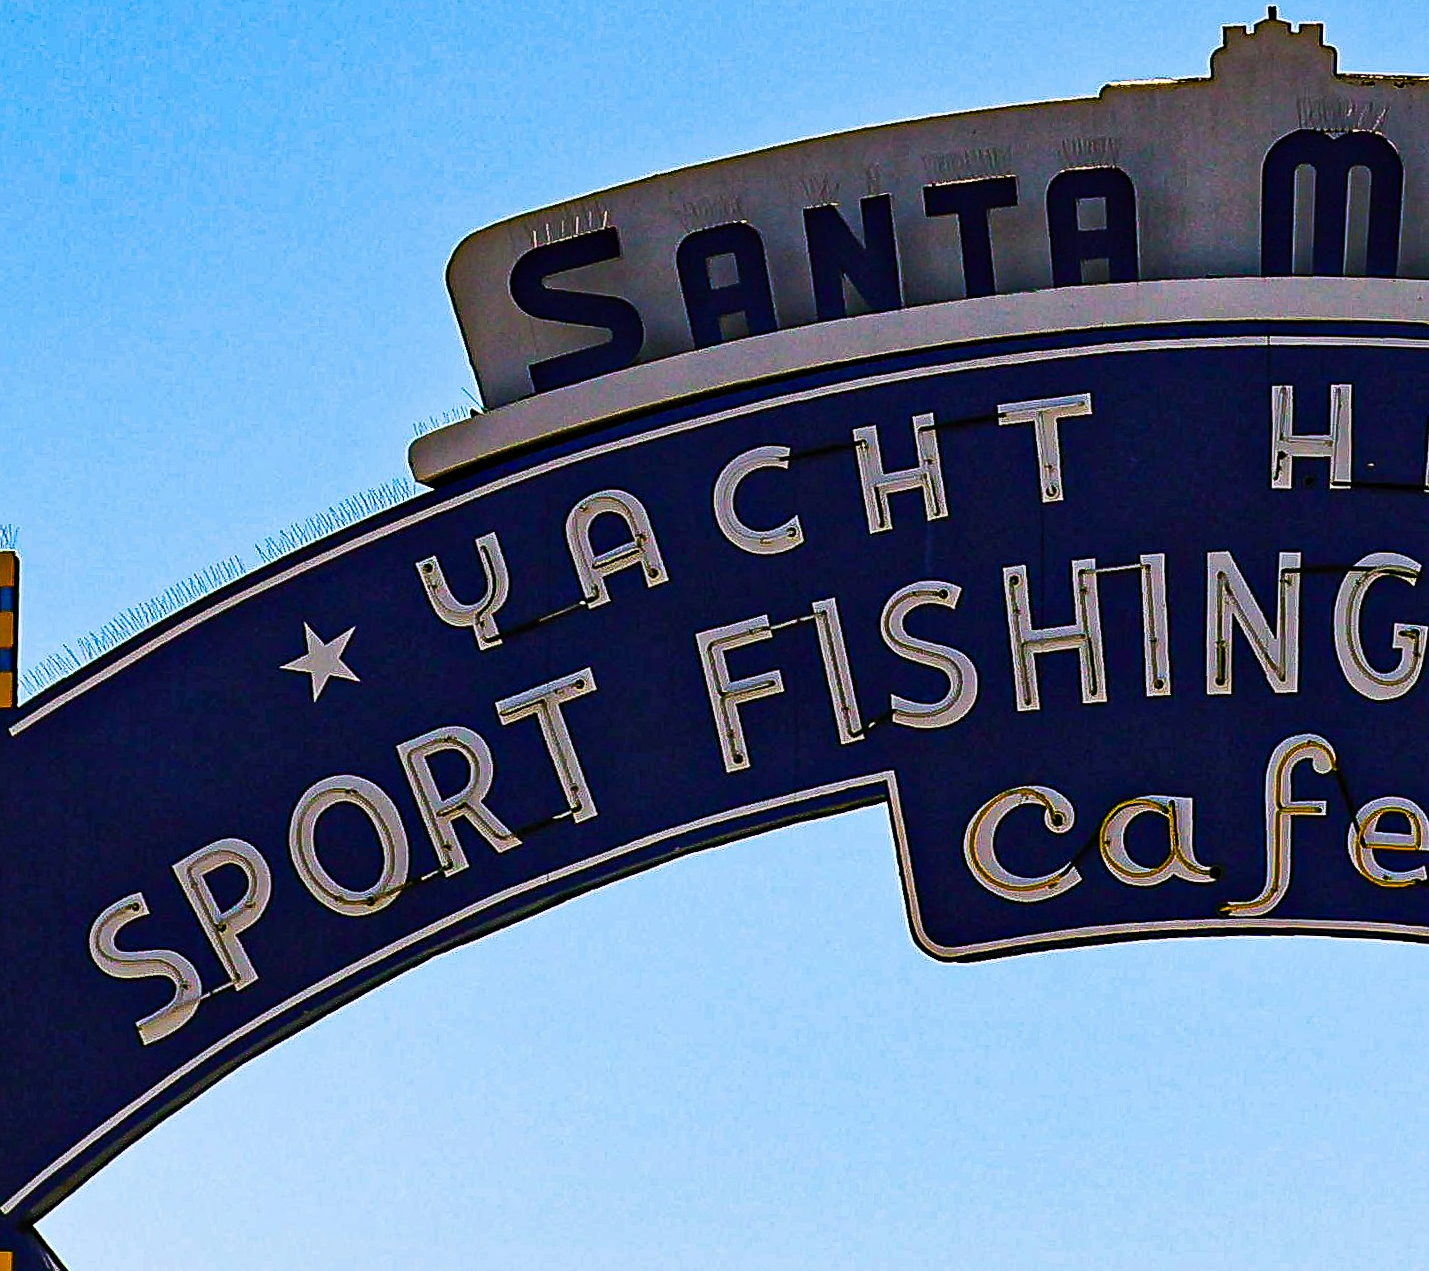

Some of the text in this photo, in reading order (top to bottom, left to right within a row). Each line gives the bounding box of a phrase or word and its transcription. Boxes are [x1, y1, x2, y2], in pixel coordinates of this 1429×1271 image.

[508, 164, 1142, 394] SANTA
[415, 391, 1093, 650] YACHT
[88, 667, 601, 1046] SPORT
[694, 550, 1428, 773] FISHING
